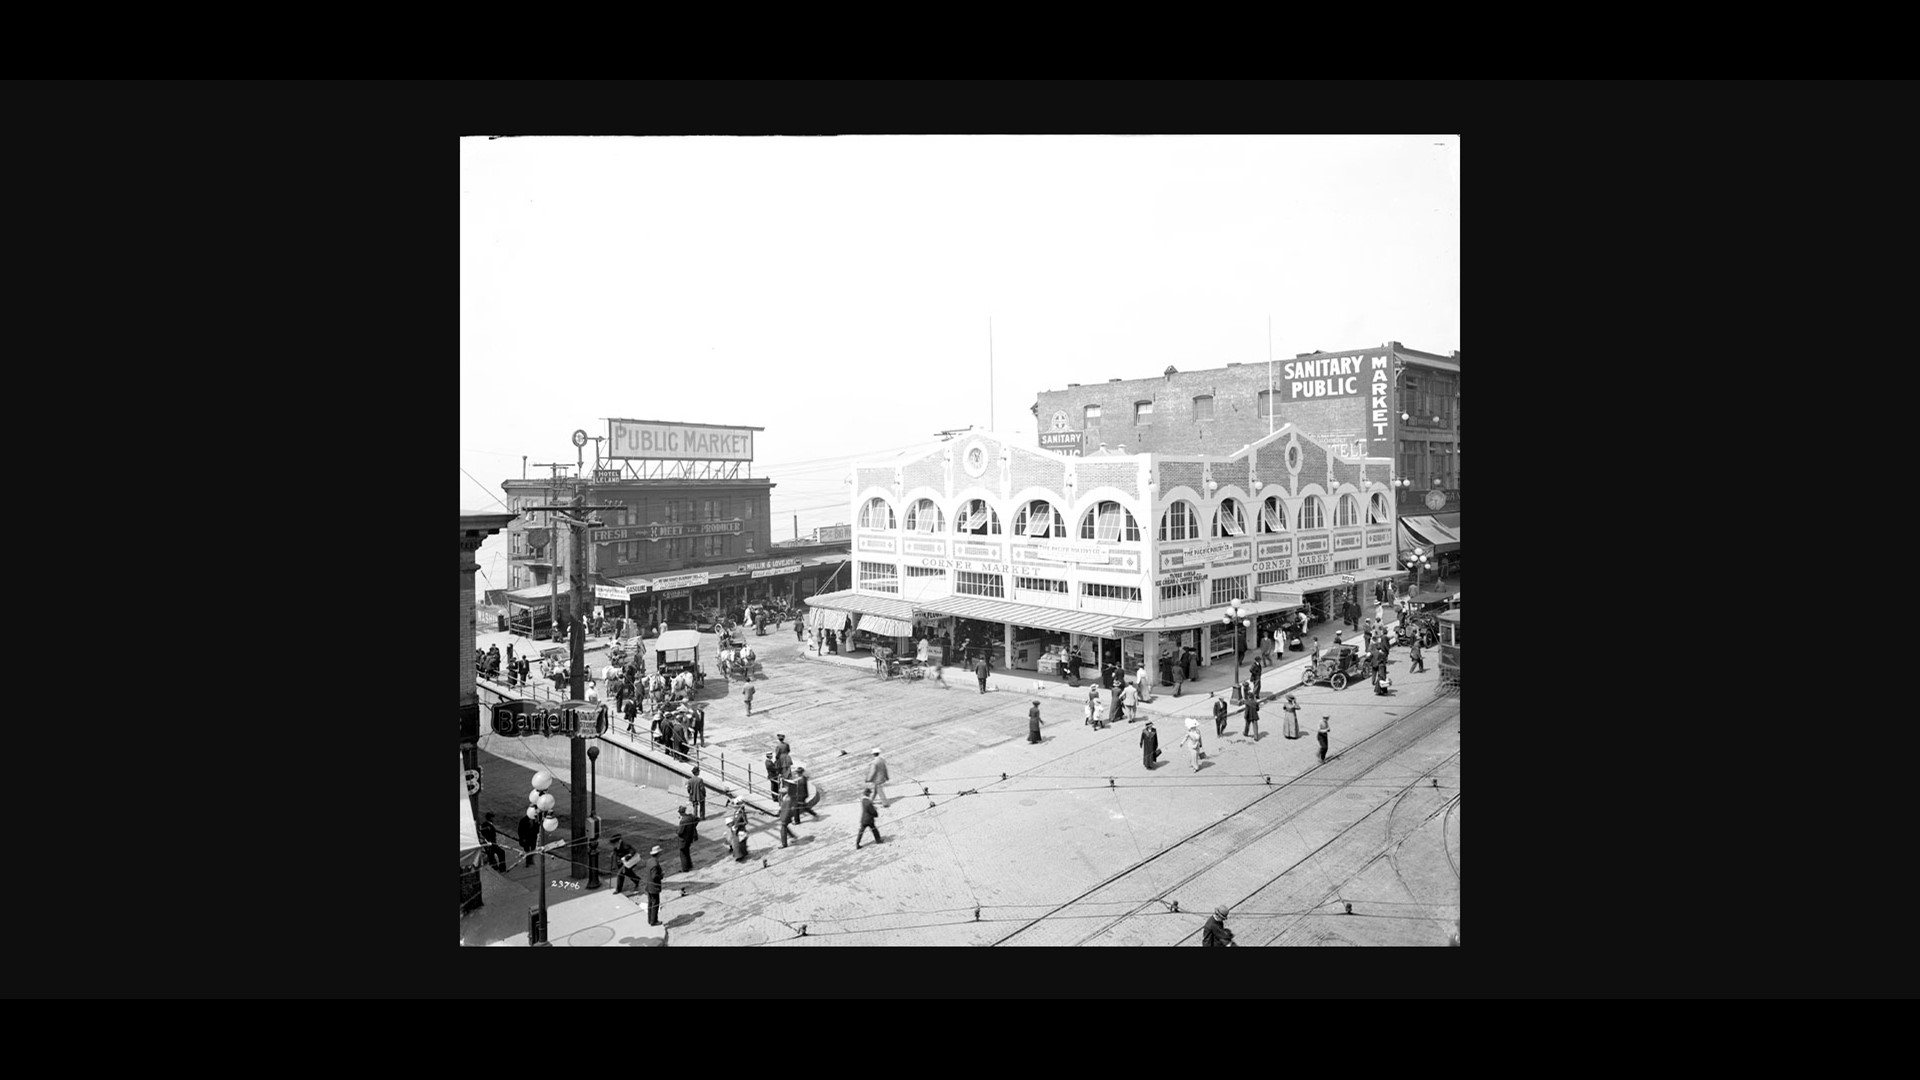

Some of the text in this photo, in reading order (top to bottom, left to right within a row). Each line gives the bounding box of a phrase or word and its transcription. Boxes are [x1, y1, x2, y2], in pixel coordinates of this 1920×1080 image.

[1284, 355, 1364, 380] SANITARY
[1291, 376, 1358, 399] PUBLIC
[1371, 355, 1389, 436] MARKET
[614, 425, 749, 453] PUBLIC MARKET
[1041, 433, 1082, 445] SANITARY
[594, 529, 628, 541] FRESH
[659, 525, 684, 536] MEET
[700, 522, 741, 534] PRODUCER
[922, 557, 1041, 576] CORNER MARKET
[1252, 553, 1334, 572] CORNER MARKET
[499, 709, 574, 733] Bartell
